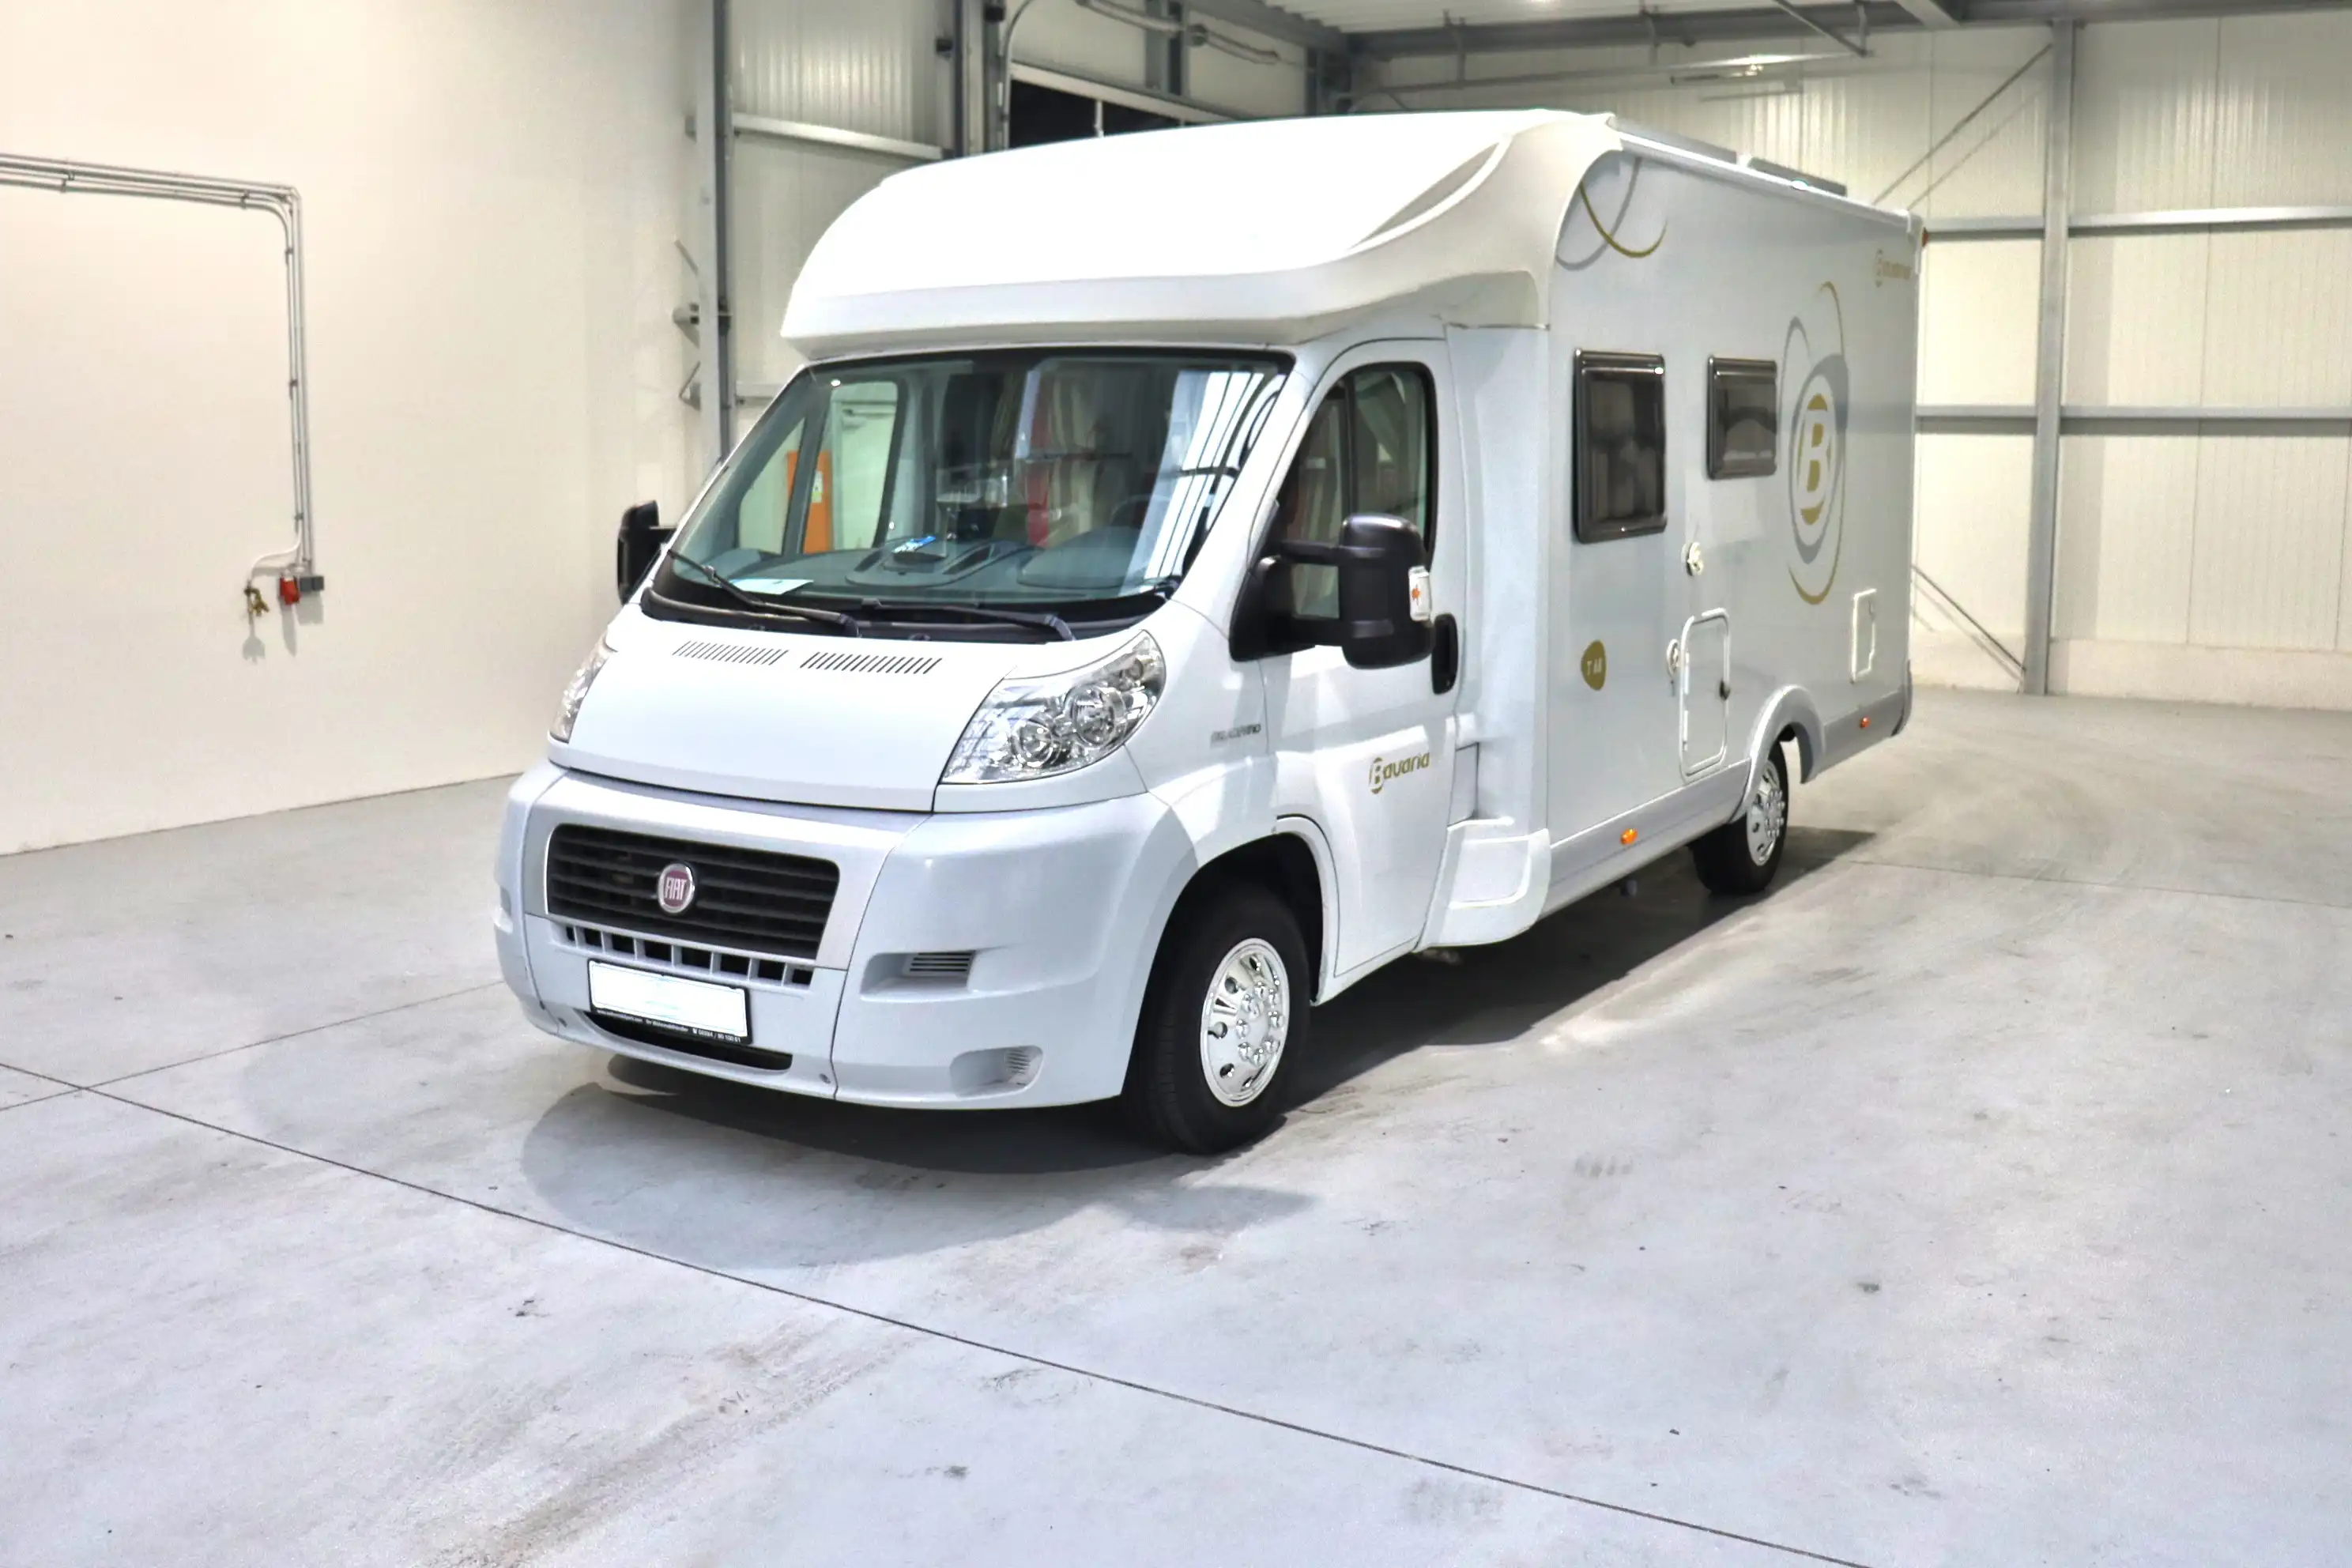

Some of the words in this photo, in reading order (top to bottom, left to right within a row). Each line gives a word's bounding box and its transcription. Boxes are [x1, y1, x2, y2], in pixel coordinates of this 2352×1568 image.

[1797, 397, 1833, 522] B
[1369, 752, 1430, 794] Bavaria
[665, 876, 688, 900] FIAT
